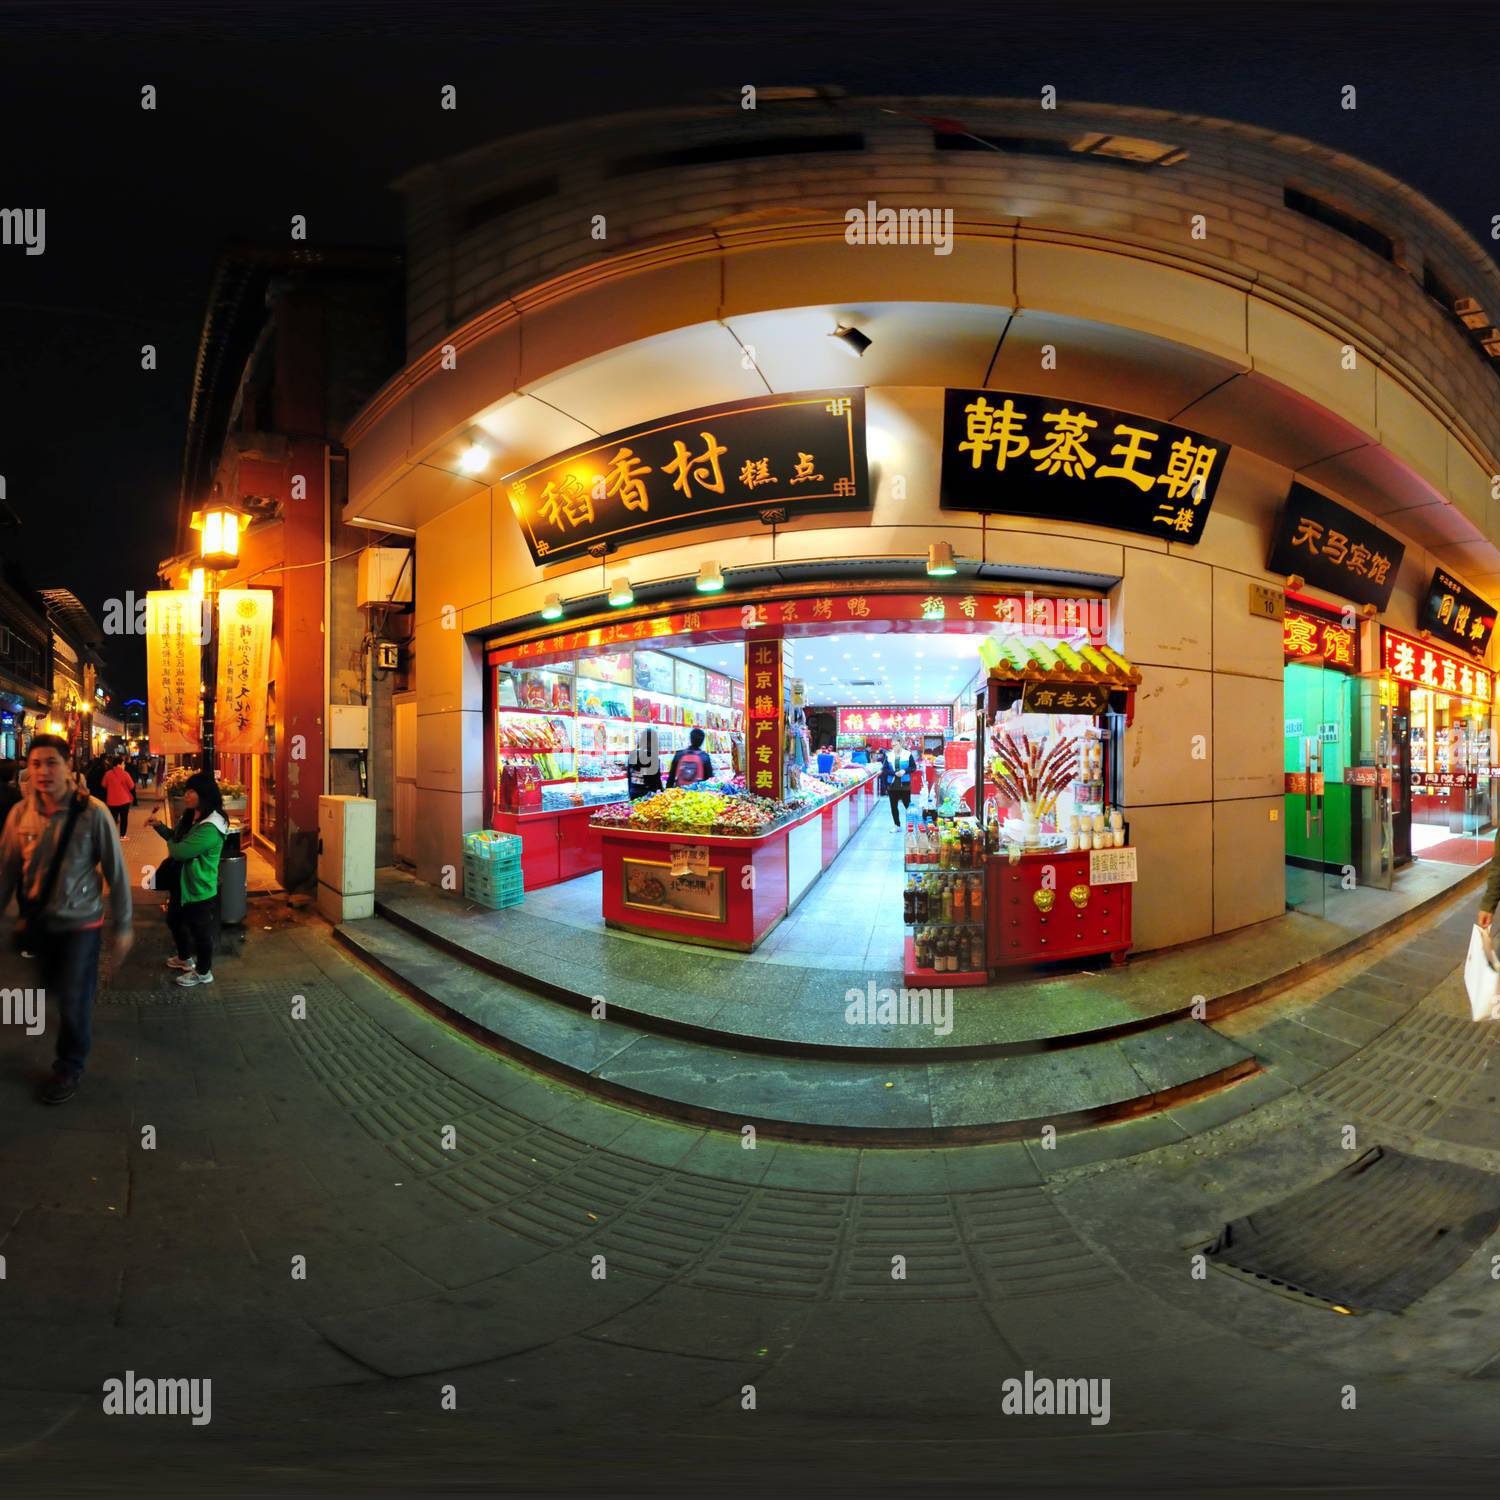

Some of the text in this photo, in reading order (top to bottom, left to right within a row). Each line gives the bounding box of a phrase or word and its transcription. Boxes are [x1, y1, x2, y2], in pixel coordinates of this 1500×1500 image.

[958, 396, 1217, 507] 韩蒸王朝
[538, 431, 825, 532] 稻香村 糕点
[1152, 504, 1195, 534] 二楼
[1291, 516, 1393, 587] 天马宾馆
[752, 595, 871, 629] 北京烤鸭
[1263, 600, 1274, 614] 10
[1284, 617, 1351, 662] 宾馆
[754, 646, 775, 790] 北京特产专卖
[1034, 690, 1098, 709] 高老太
[844, 711, 945, 731] 稻香村糕点
